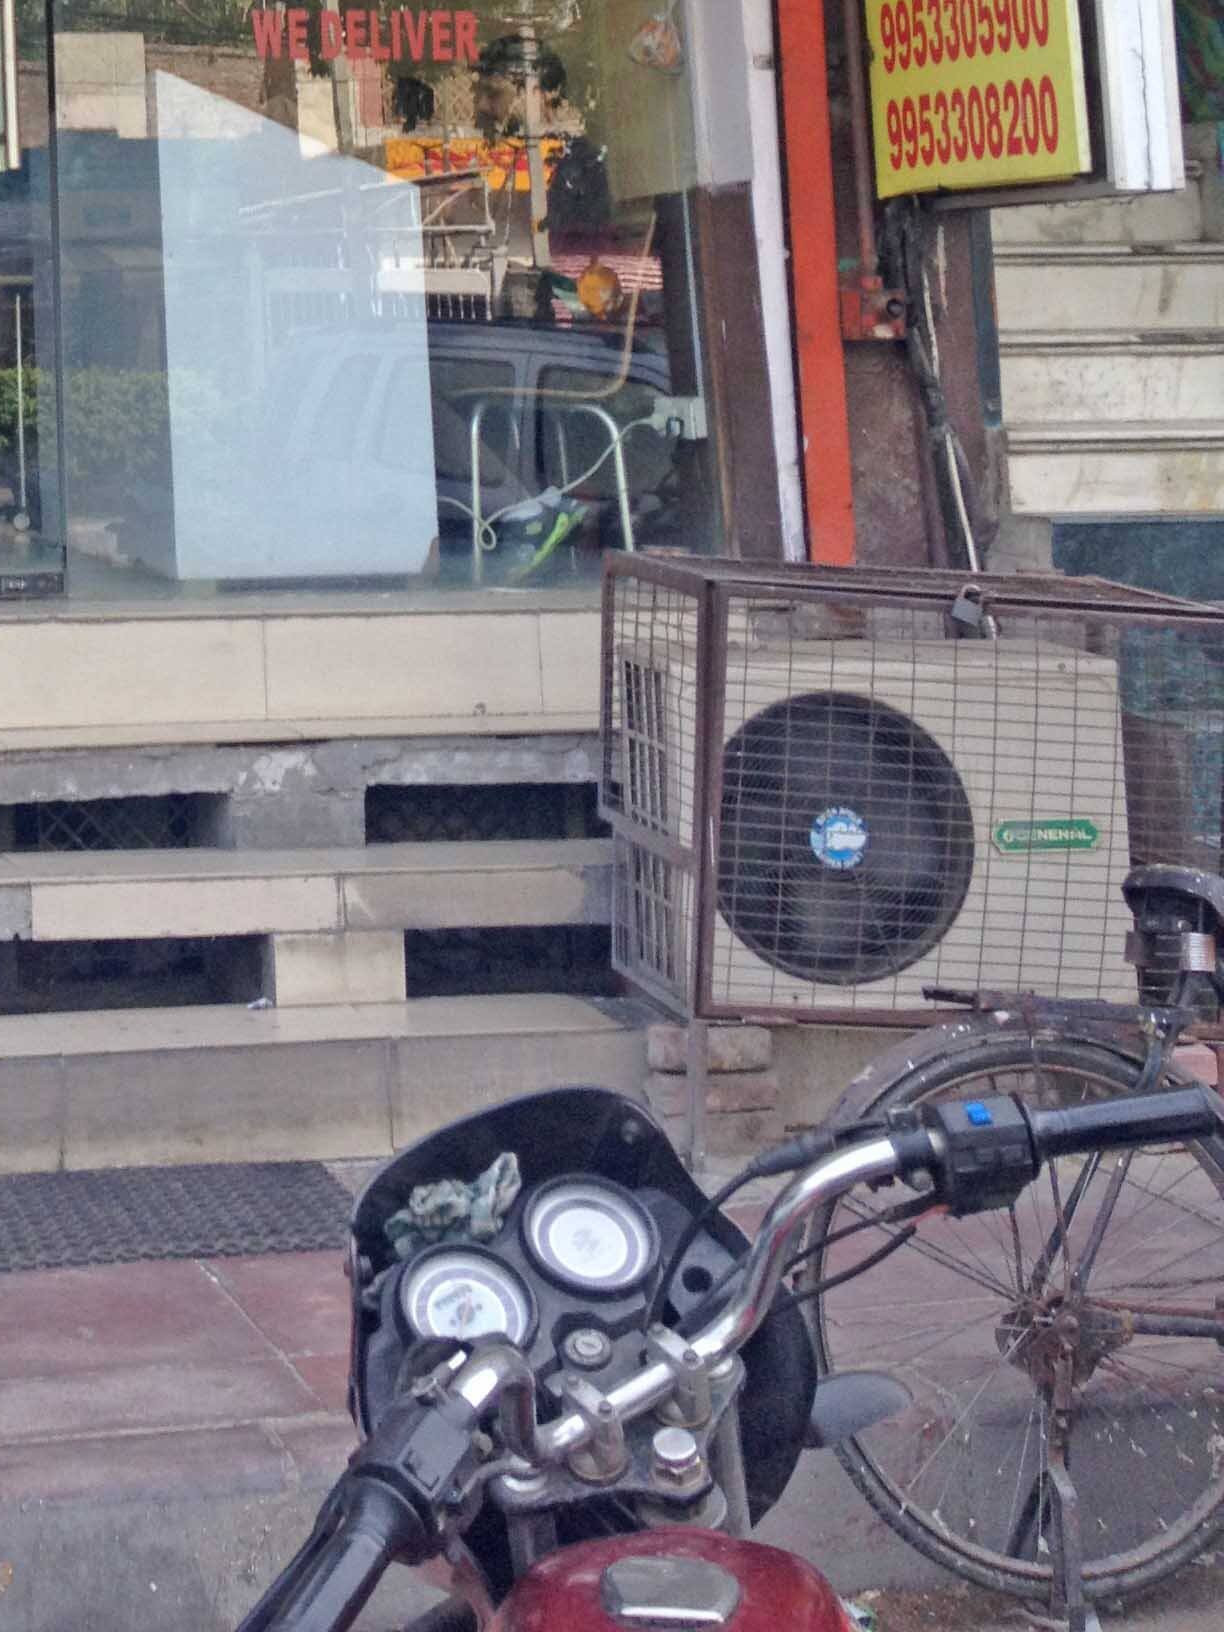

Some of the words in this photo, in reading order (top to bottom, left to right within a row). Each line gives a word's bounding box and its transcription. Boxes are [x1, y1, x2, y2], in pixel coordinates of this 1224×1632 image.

[251, 8, 311, 61] WE
[319, 9, 479, 65] DELIVER
[886, 74, 1059, 170] 9953308200
